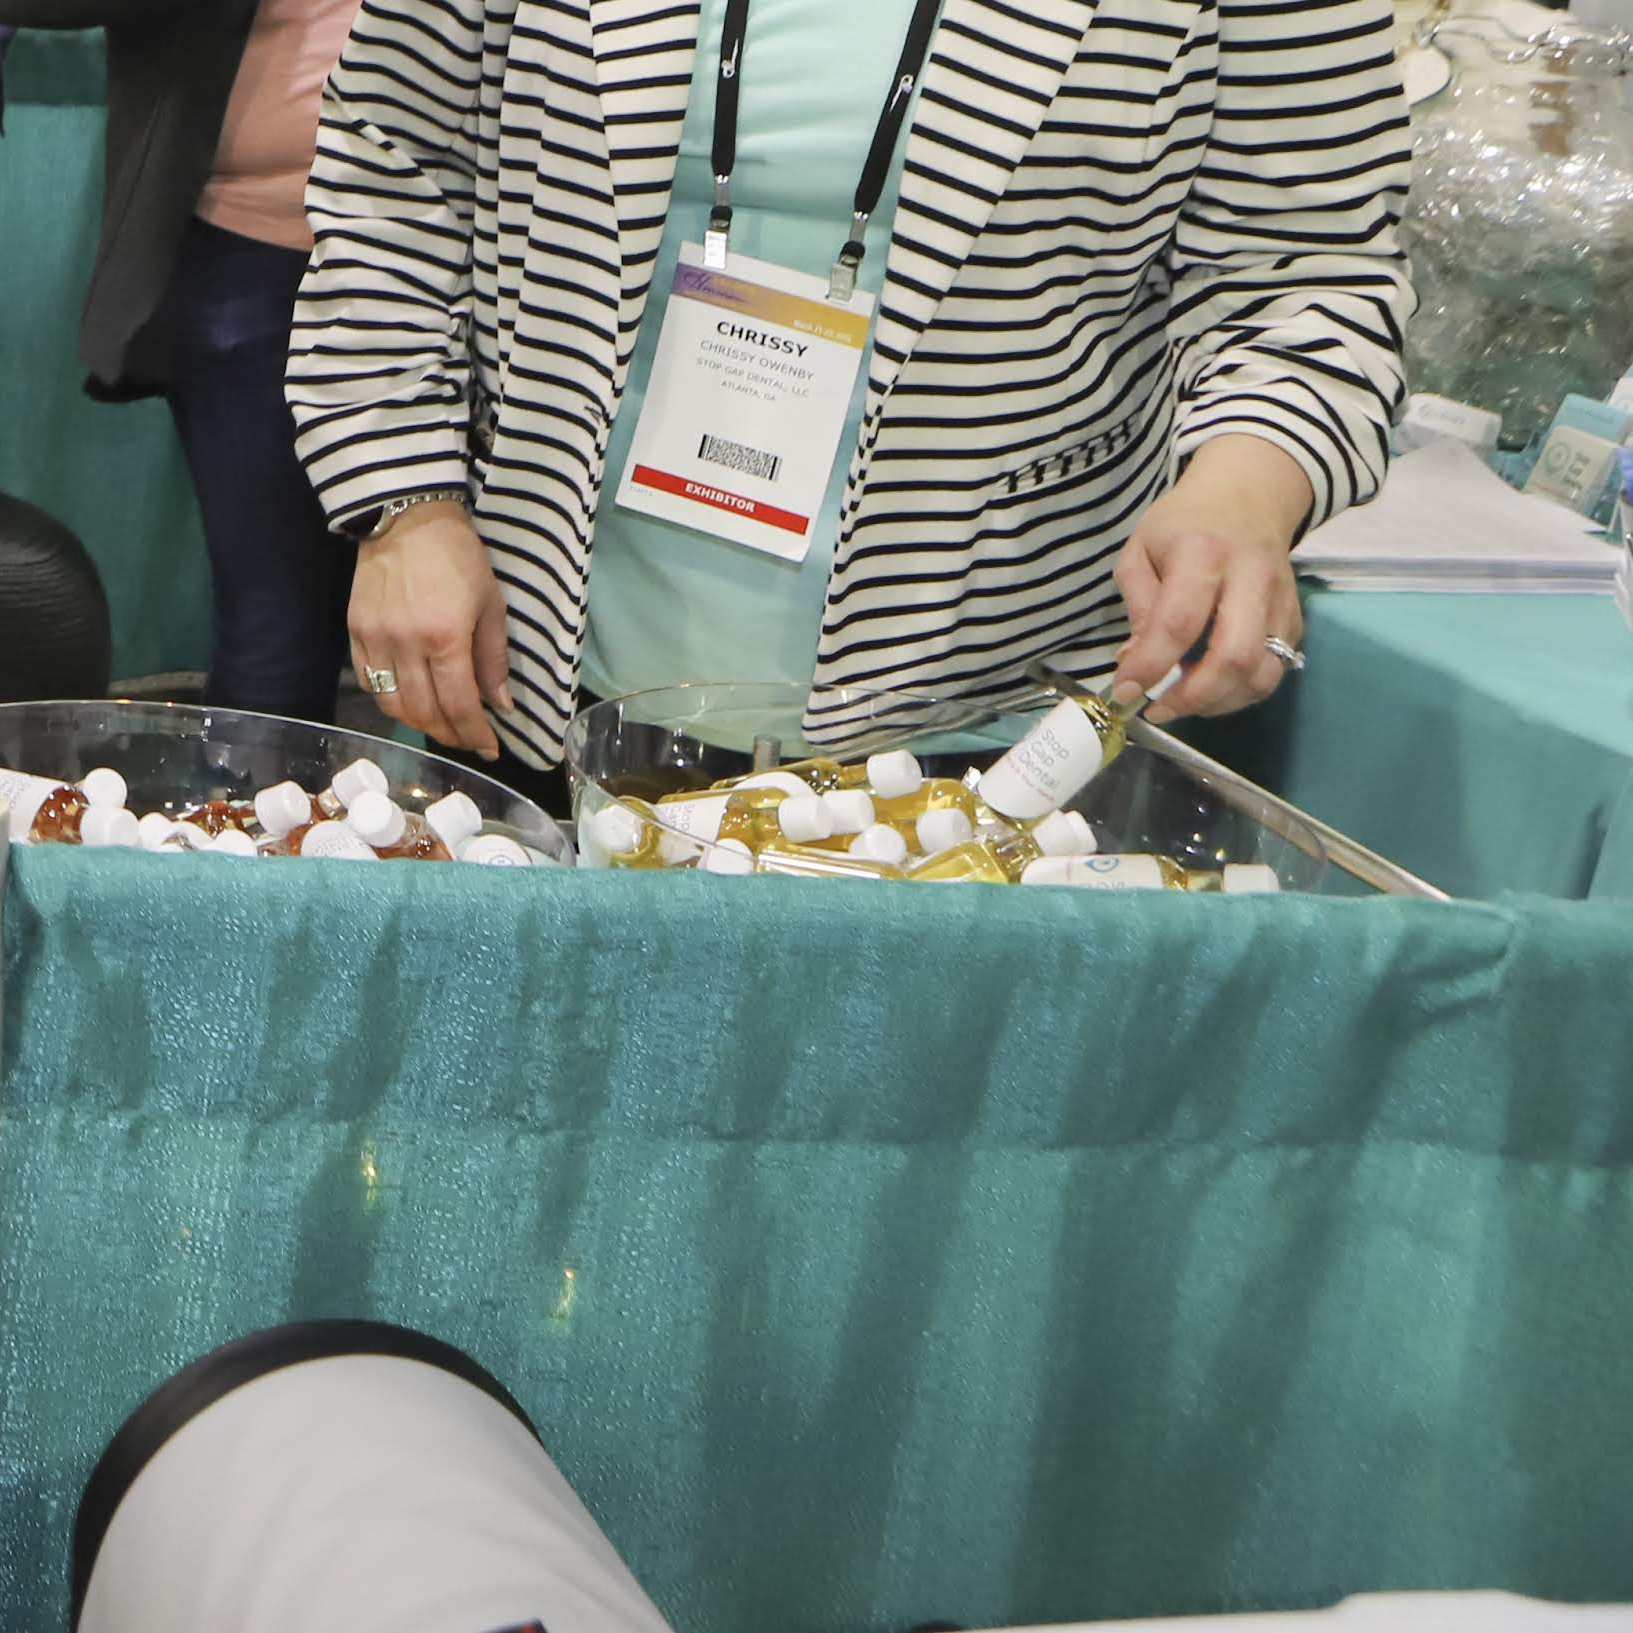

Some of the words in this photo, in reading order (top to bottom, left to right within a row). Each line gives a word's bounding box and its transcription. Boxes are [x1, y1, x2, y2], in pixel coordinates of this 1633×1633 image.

[716, 321, 809, 358] CHRISSY
[695, 357, 723, 372] STOP
[724, 365, 745, 378] GAP
[791, 384, 809, 398] LLC
[700, 340, 756, 364] CHRISSY
[759, 358, 815, 382] OWENBY
[685, 482, 756, 514] EXHIBITOR
[1030, 740, 1055, 768] Gap
[1041, 728, 1071, 760] Stop
[1018, 751, 1060, 789] Dental
